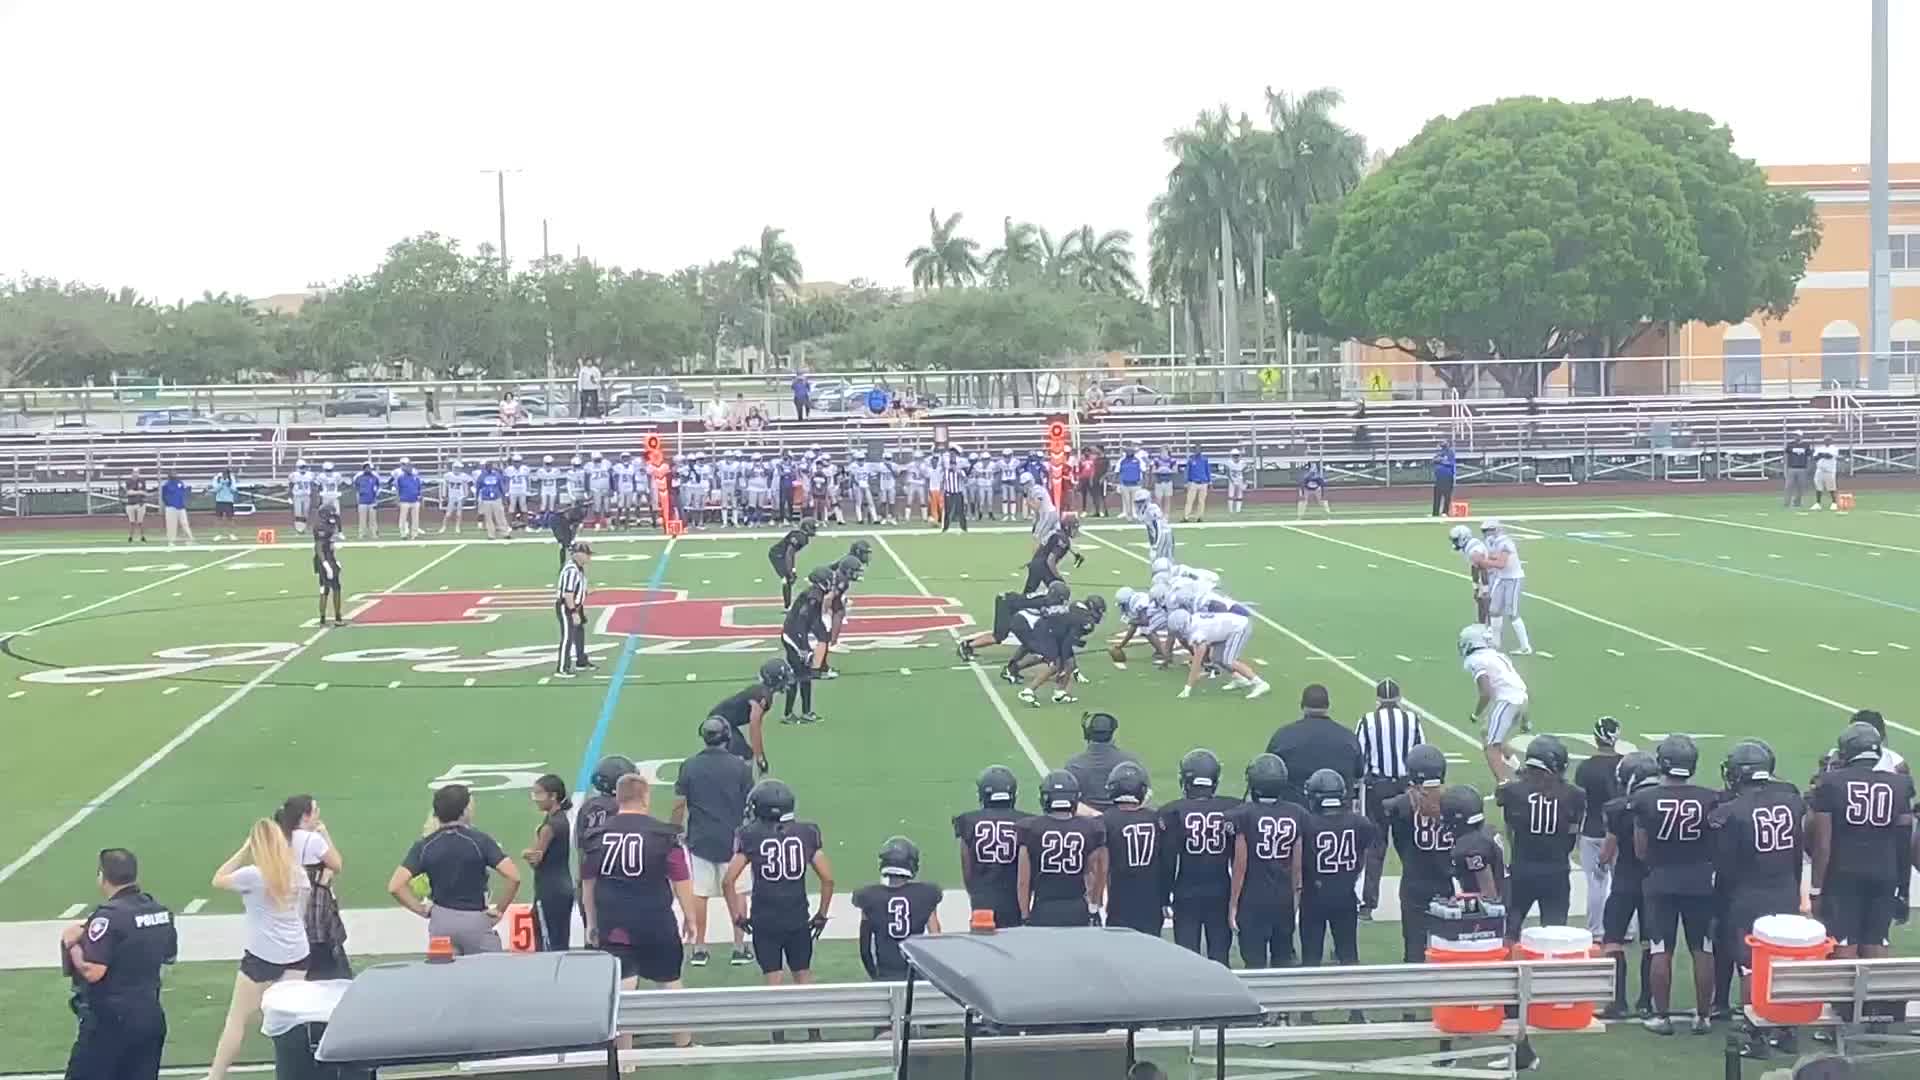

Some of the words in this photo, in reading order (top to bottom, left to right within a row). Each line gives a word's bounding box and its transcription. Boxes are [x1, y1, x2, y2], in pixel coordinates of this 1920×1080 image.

[1528, 792, 1558, 834] 11
[1657, 799, 1703, 841] 72
[1846, 781, 1893, 826] 50
[975, 821, 1017, 863] 25
[1122, 823, 1155, 866] 17
[1184, 811, 1226, 854] 33
[1256, 816, 1297, 859] 32
[1752, 805, 1794, 851] 62
[601, 833, 643, 876] 70
[760, 836, 804, 881] 30
[1041, 831, 1084, 873] 23
[1316, 829, 1357, 873] 24
[135, 911, 169, 928] POLICE
[888, 896, 910, 939] 3
